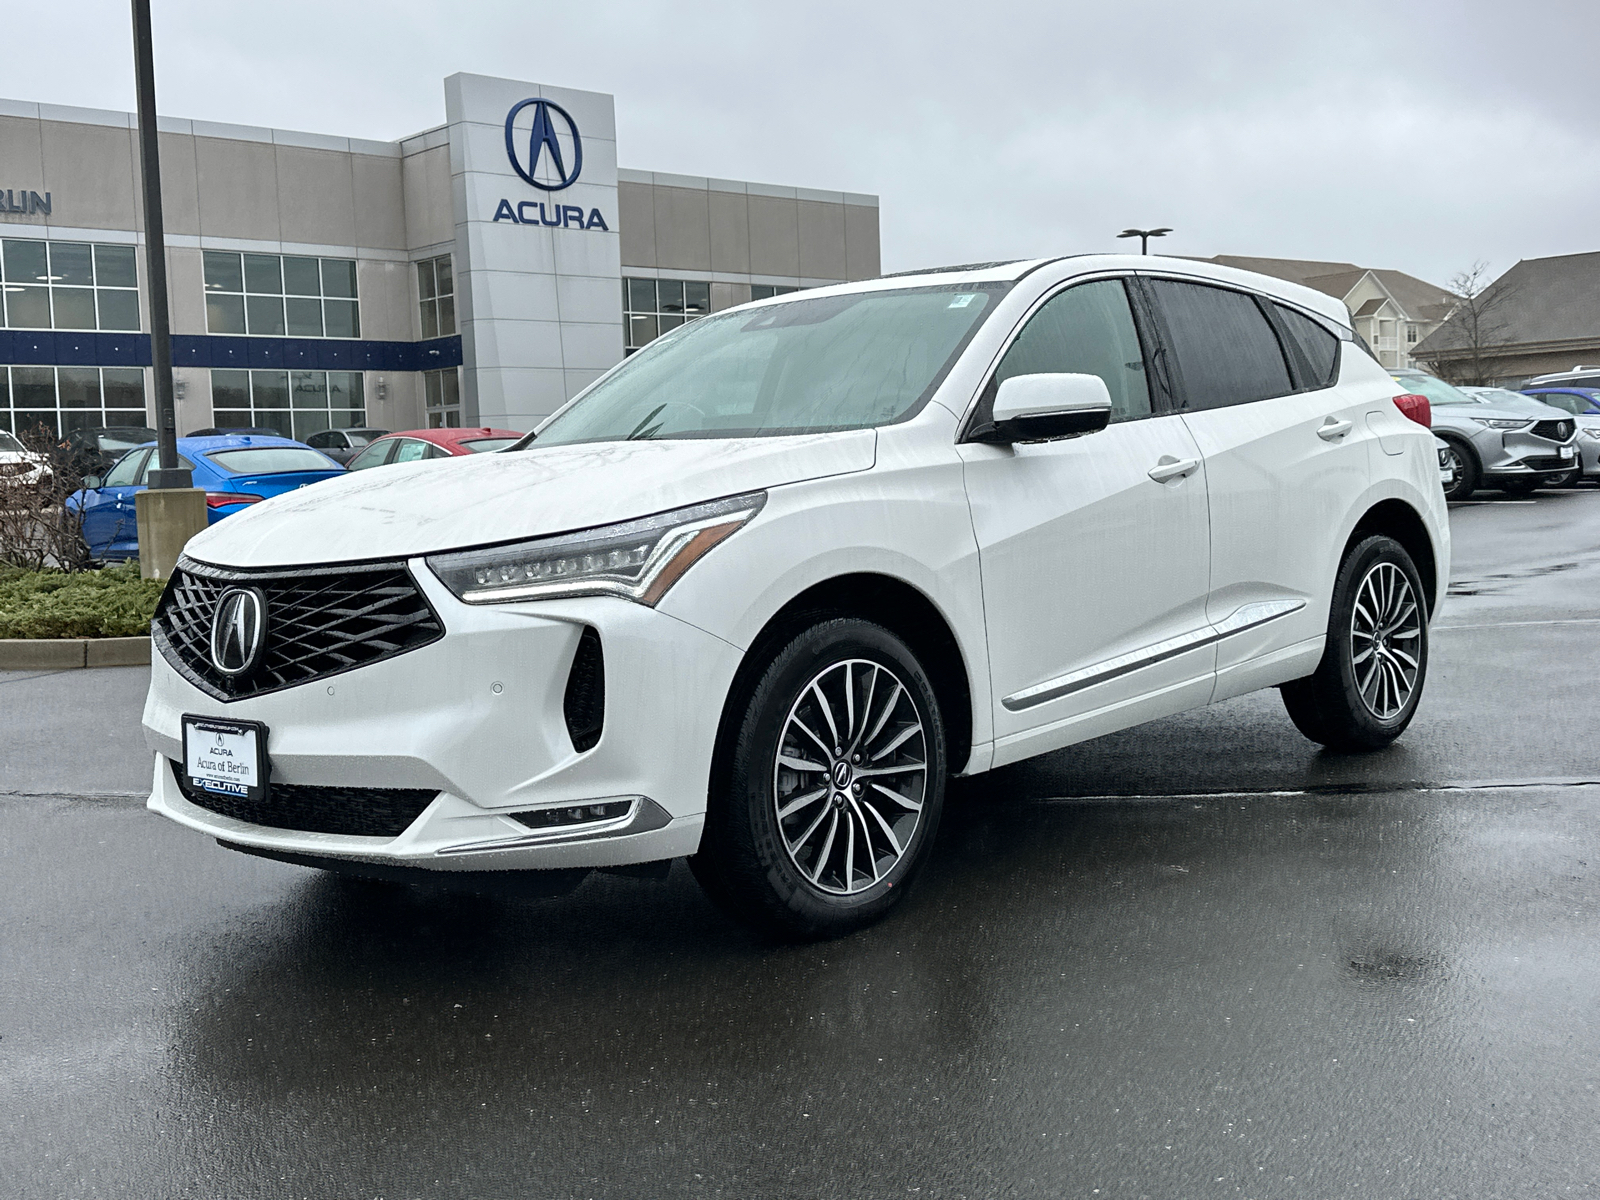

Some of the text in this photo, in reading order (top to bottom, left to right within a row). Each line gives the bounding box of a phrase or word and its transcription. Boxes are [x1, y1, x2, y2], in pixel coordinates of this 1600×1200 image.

[492, 198, 609, 231] ACURA
[294, 384, 341, 393] ACUA
[210, 748, 233, 757] ACURA
[197, 756, 249, 775] Acura of Berlin
[193, 778, 248, 794] EXECUTIVE
